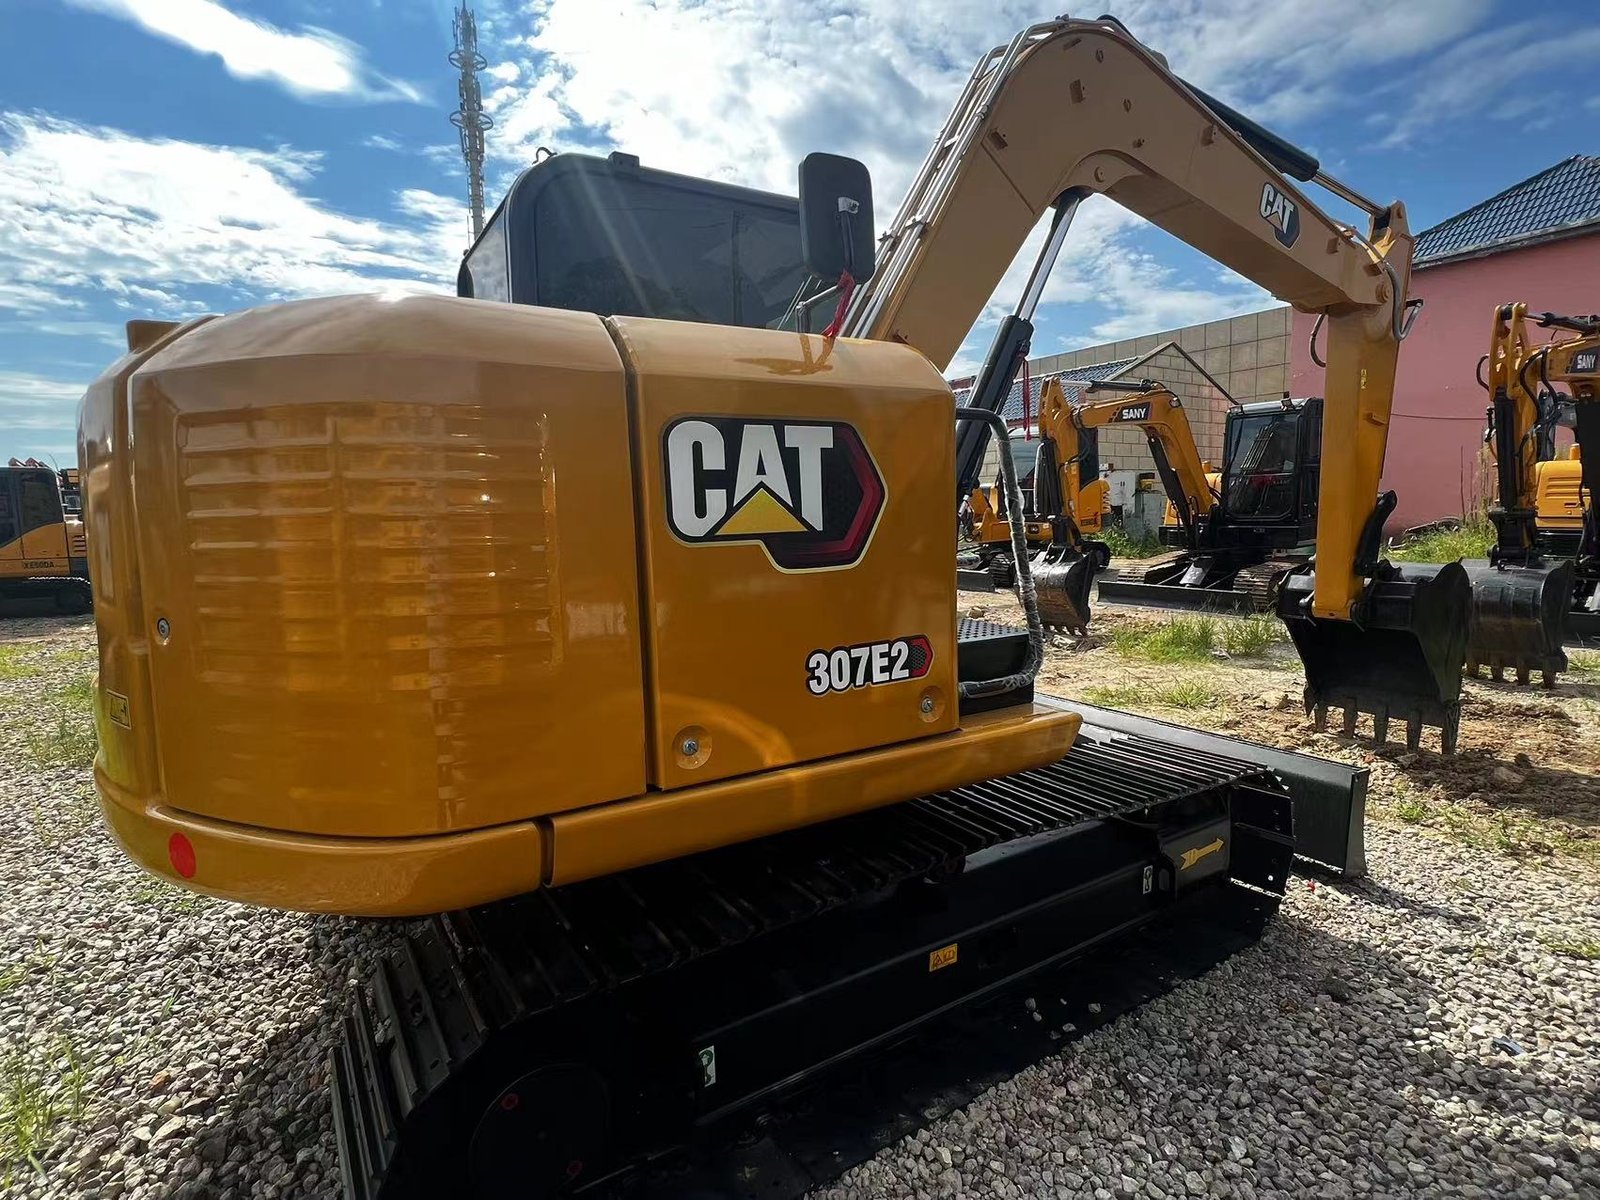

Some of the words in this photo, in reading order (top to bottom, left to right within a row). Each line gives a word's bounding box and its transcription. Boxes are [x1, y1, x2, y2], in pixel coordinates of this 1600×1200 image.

[1260, 183, 1295, 234] CAT
[1576, 354, 1596, 369] SANY
[1122, 407, 1147, 420] SANY
[667, 420, 834, 537] CAT
[807, 640, 910, 694] 307E2
